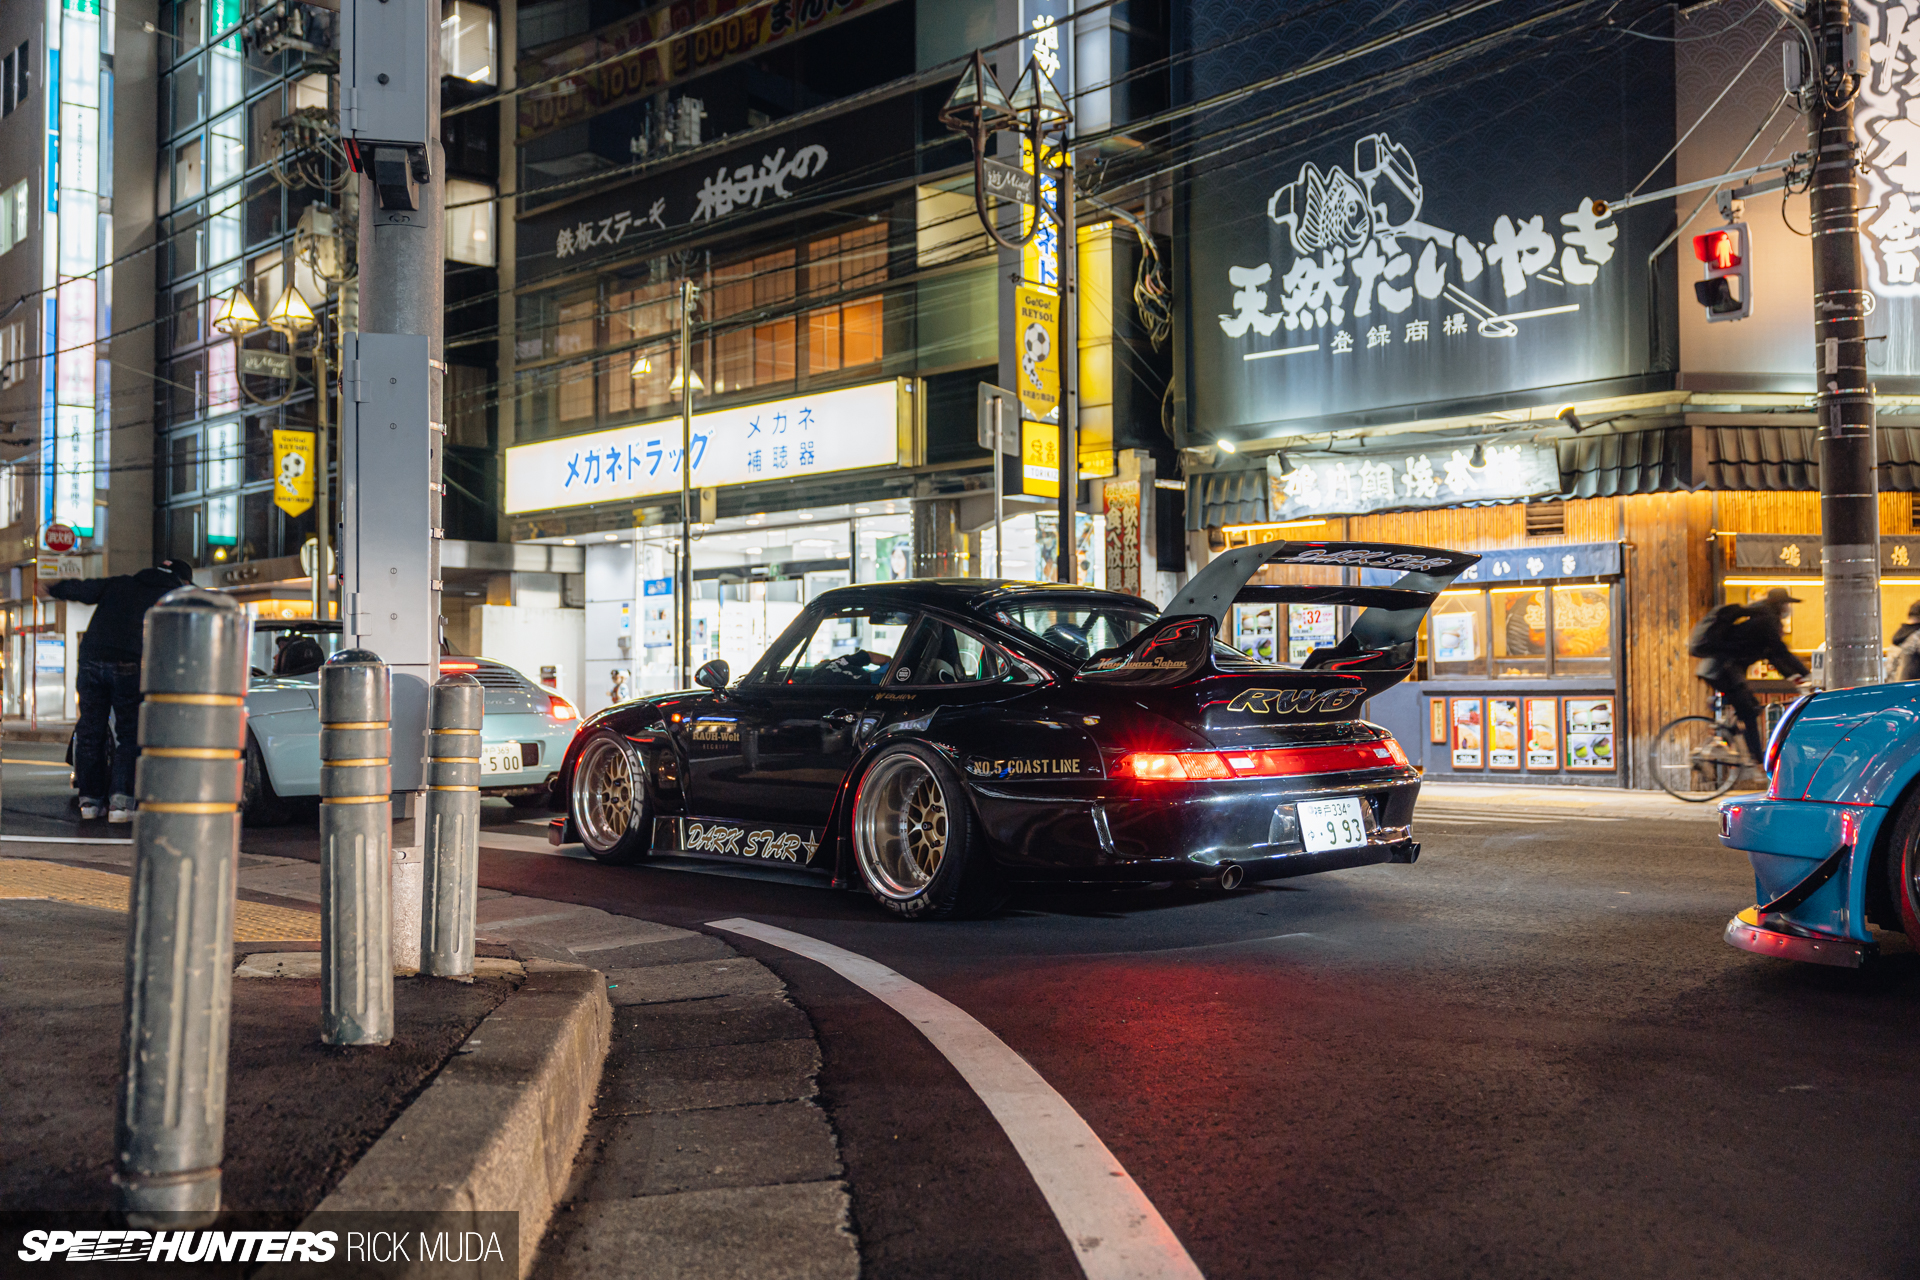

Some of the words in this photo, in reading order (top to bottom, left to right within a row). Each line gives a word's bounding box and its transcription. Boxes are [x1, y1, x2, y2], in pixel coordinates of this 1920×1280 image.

[556, 197, 666, 258] 鉄板ステーキ
[1219, 197, 1618, 337] 天然たいやき
[1021, 307, 1055, 323] REYSOL
[1330, 313, 1468, 354] 登録商標
[564, 431, 714, 488] メガネドラッグ
[747, 406, 815, 438] メガネ
[747, 441, 815, 473] 補聴器
[47, 531, 73, 545] 消火栓
[1154, 656, 1187, 669] Japan
[1227, 688, 1367, 714] RWB
[692, 731, 740, 742] RAUH-Welt
[1007, 759, 1050, 774] COAST
[1052, 758, 1080, 773] LINE
[687, 822, 744, 855] DARK
[743, 829, 801, 862] STAR
